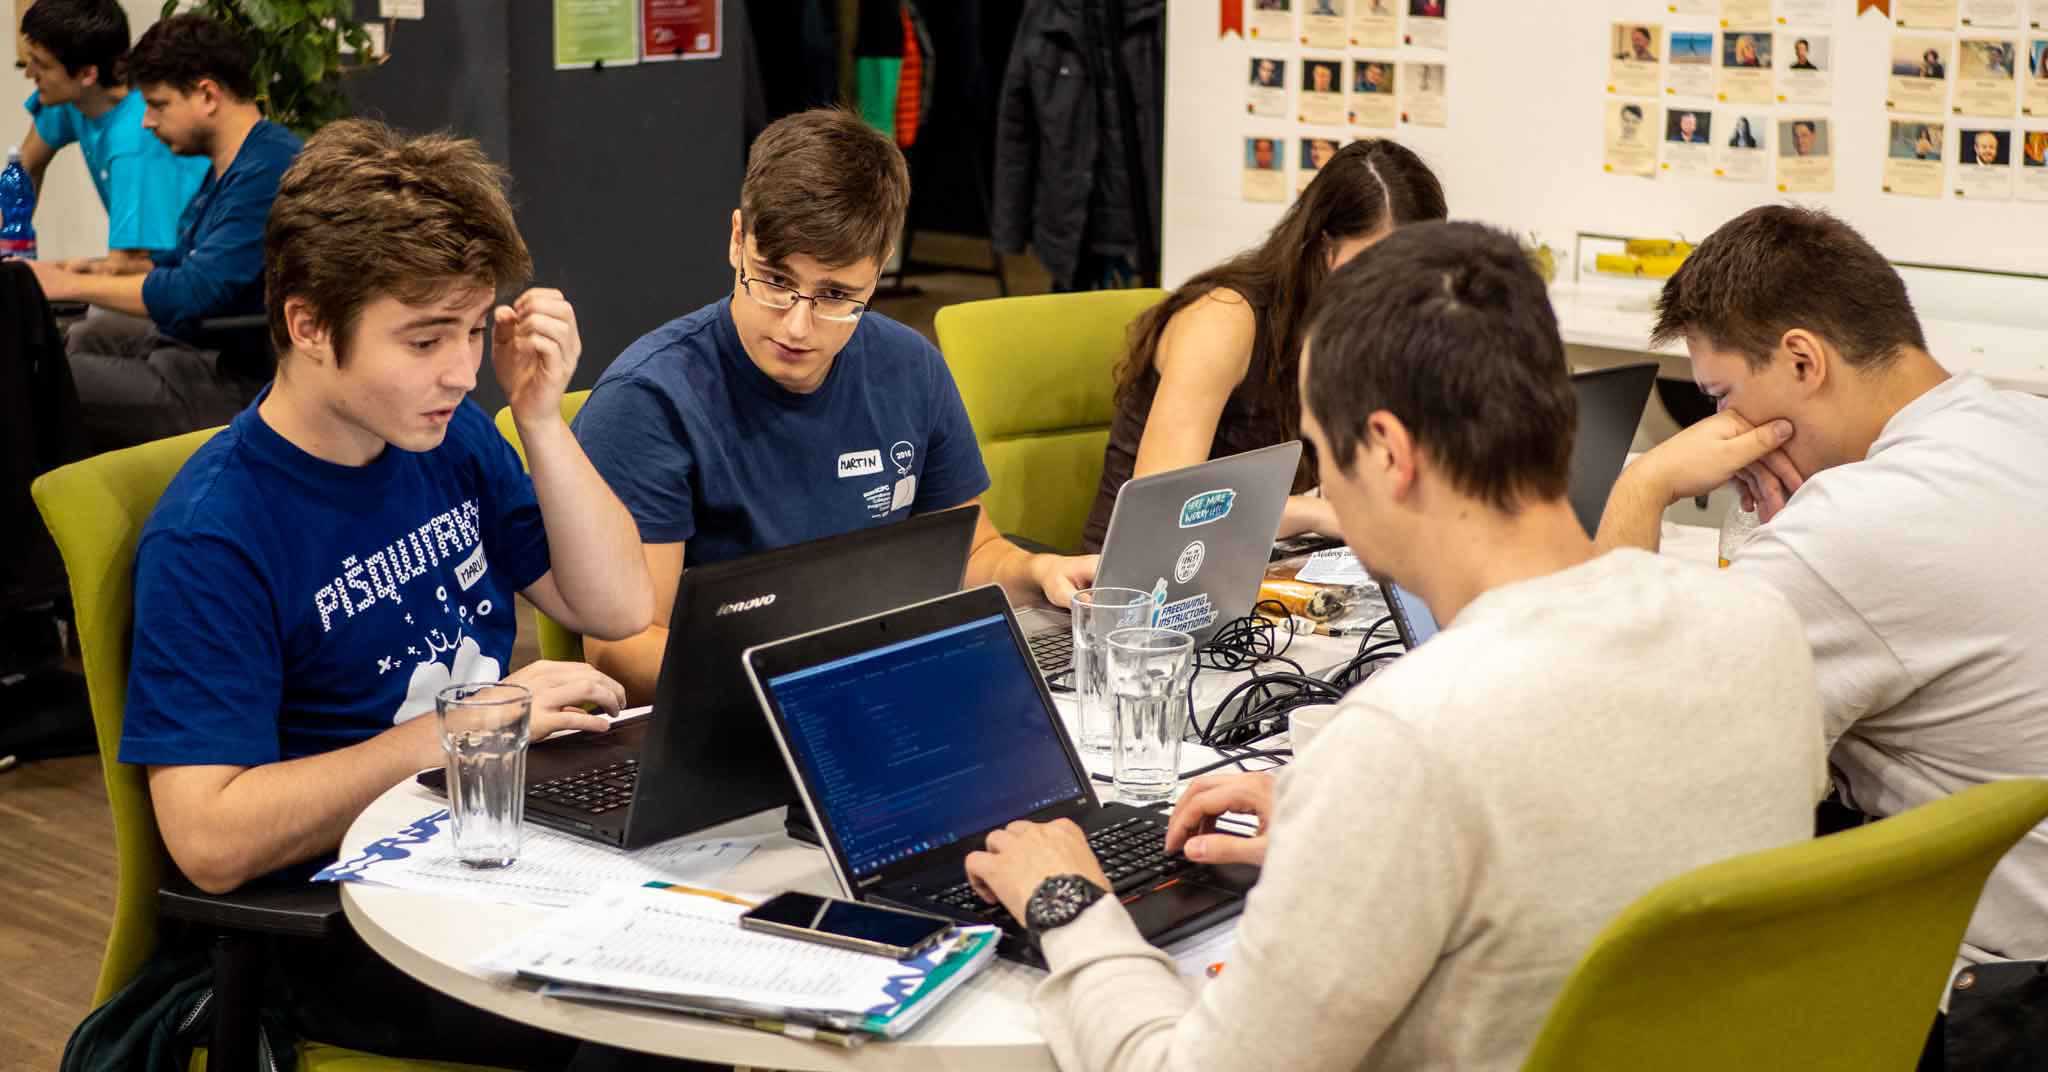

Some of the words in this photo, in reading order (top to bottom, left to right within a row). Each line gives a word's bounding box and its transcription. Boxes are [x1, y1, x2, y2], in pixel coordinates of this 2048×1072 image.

[840, 456, 876, 470] MARTIN
[1161, 597, 1207, 616] FREEDIVING
[1157, 607, 1209, 627] INSTRUCTORS
